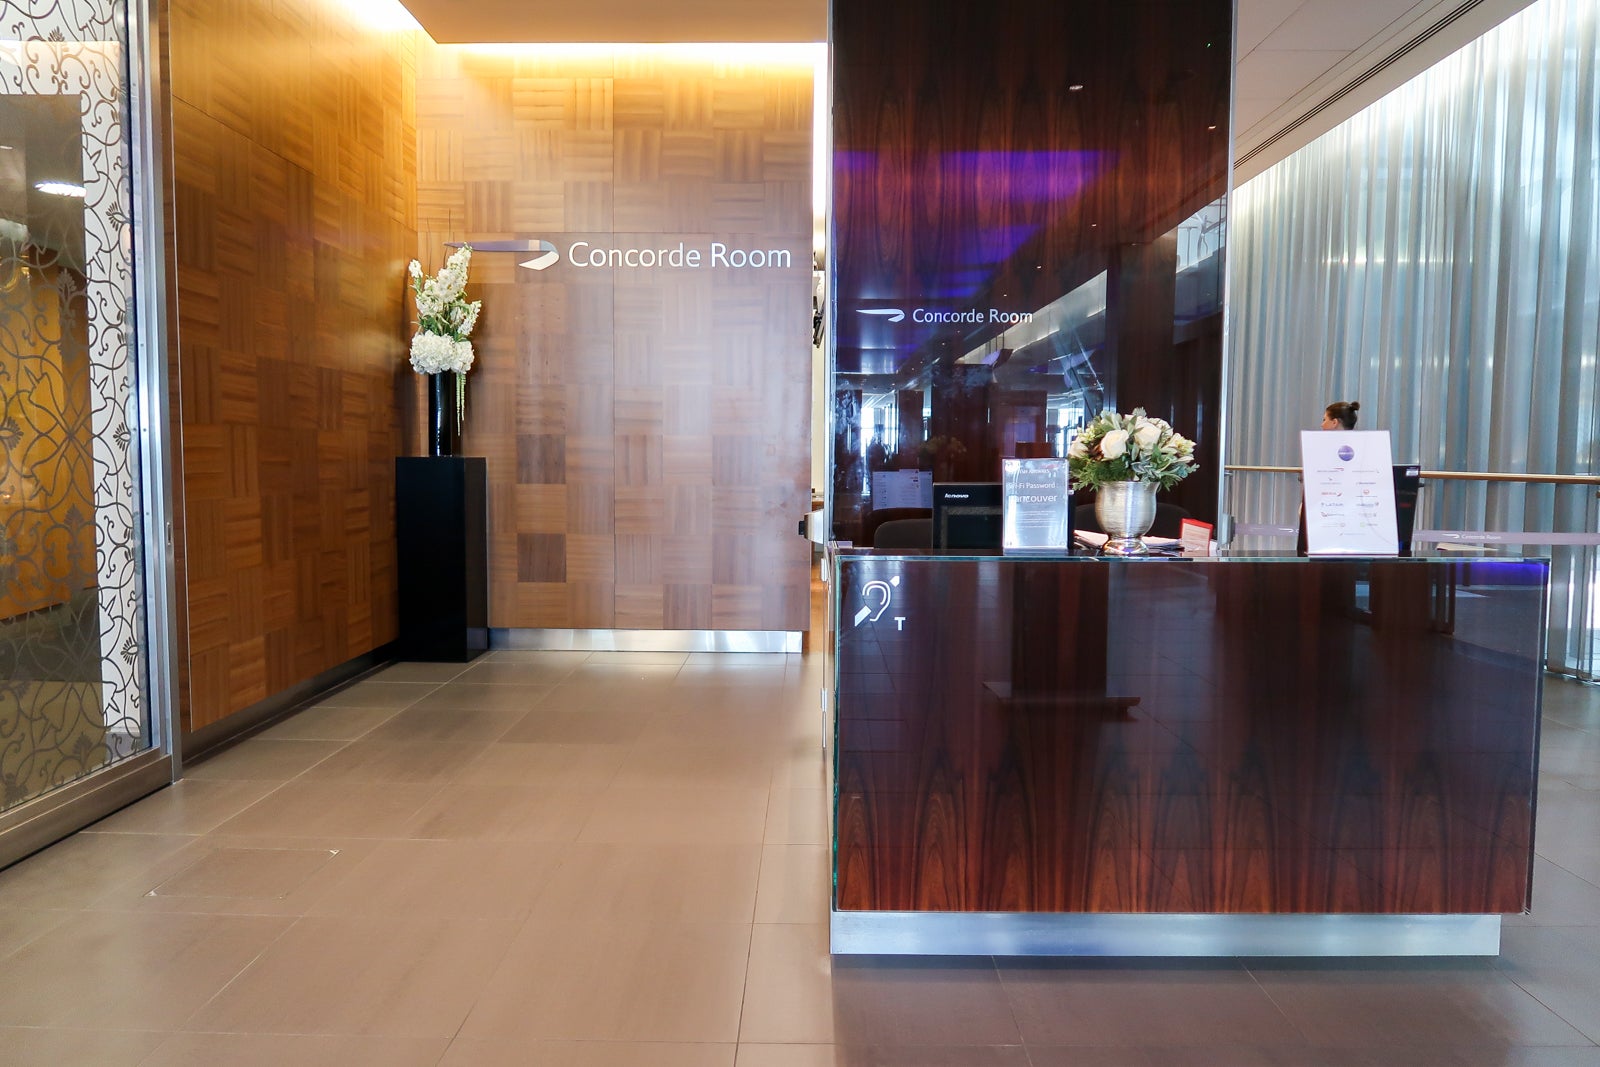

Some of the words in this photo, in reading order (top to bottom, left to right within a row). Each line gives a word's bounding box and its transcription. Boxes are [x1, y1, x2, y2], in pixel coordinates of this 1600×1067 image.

[568, 241, 700, 267] Concorde
[711, 242, 791, 267] Room
[912, 308, 984, 323] Concorde
[989, 308, 1033, 323] Room
[1009, 495, 1057, 503] ancouver
[894, 616, 906, 631] T
